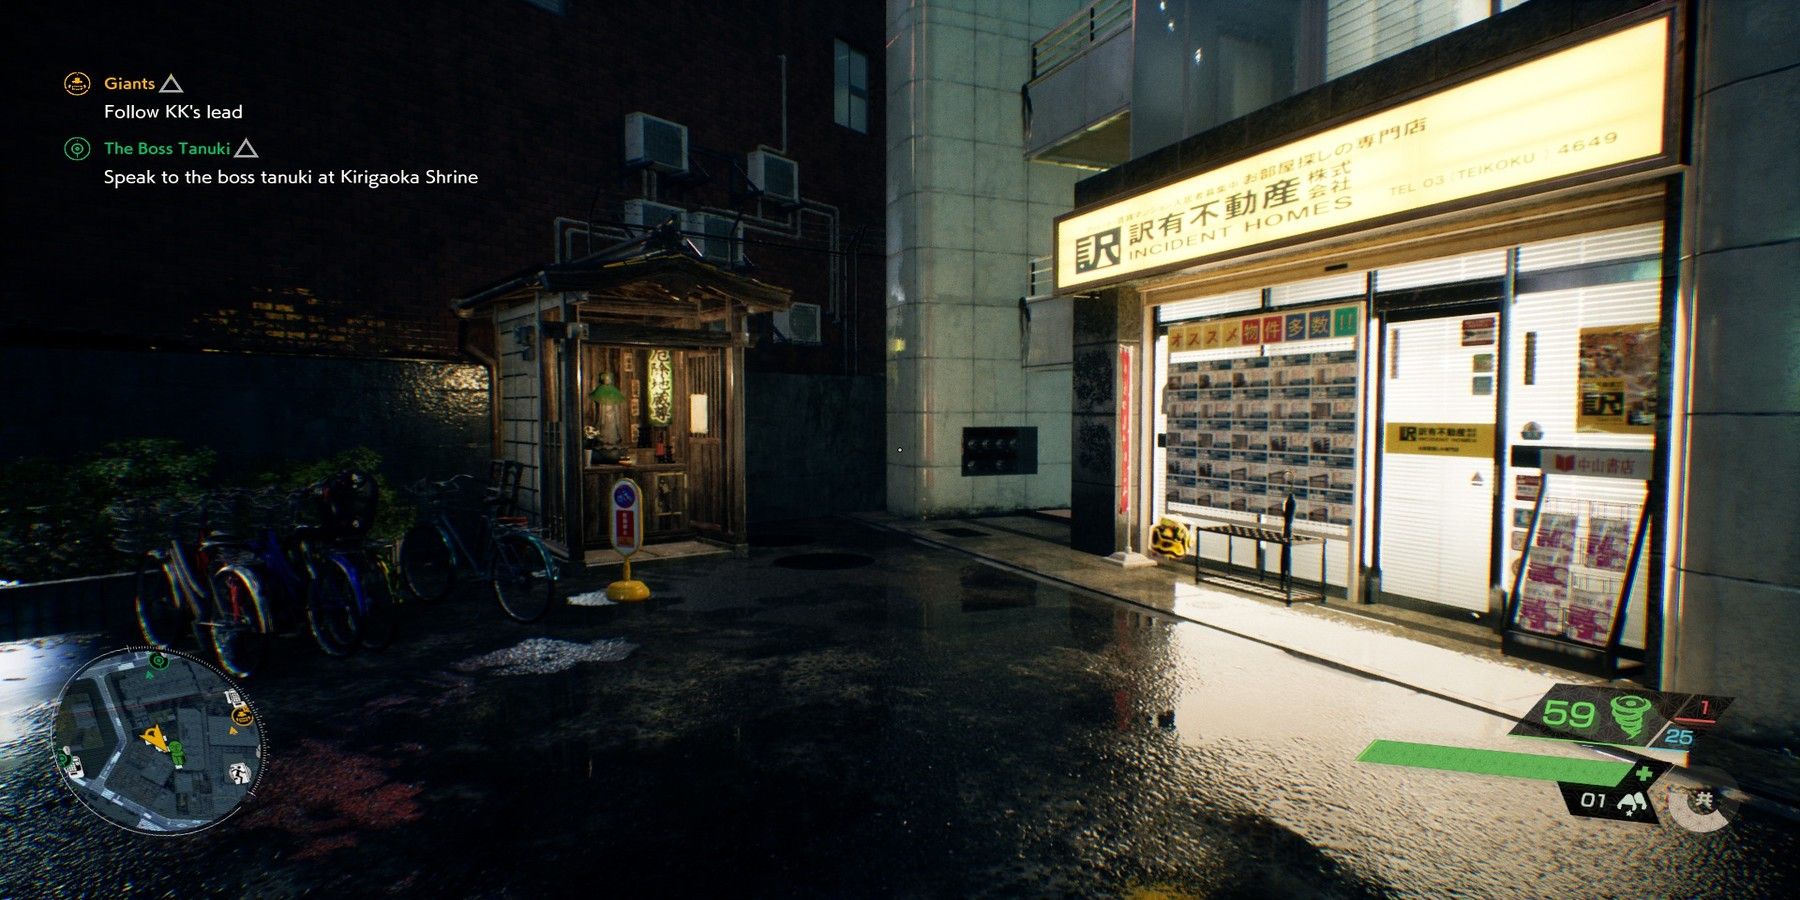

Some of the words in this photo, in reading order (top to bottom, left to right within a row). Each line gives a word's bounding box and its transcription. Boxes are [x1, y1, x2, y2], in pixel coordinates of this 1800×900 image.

[1243, 117, 1429, 184] お部屋探しの専門店
[1308, 159, 1352, 184] 株式
[1388, 183, 1417, 197] TEL
[1422, 174, 1445, 189] 03
[1557, 131, 1619, 156] 4649
[1129, 177, 1301, 246] 訳有不動産
[1308, 177, 1353, 200] 会社
[1129, 225, 1233, 262] INCIDENT
[1244, 195, 1353, 233] HOMES
[1577, 456, 1636, 475] 中山書店
